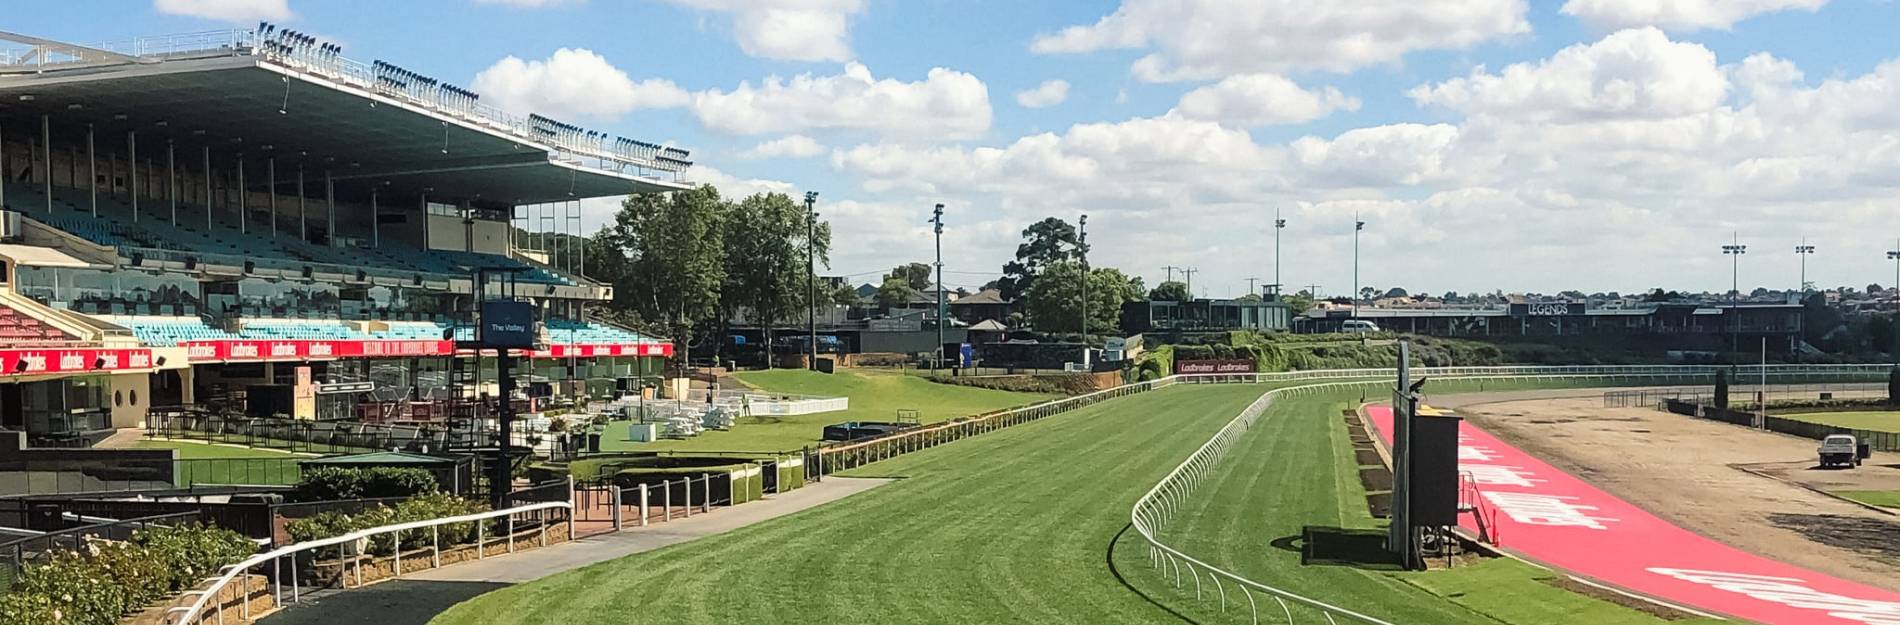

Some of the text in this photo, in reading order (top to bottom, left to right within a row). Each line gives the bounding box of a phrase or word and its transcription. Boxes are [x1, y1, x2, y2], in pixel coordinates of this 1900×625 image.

[1528, 303, 1568, 315] LEGENDS
[505, 324, 526, 332] Valley
[1181, 363, 1250, 372] Ladbrokes Ladbrokes
